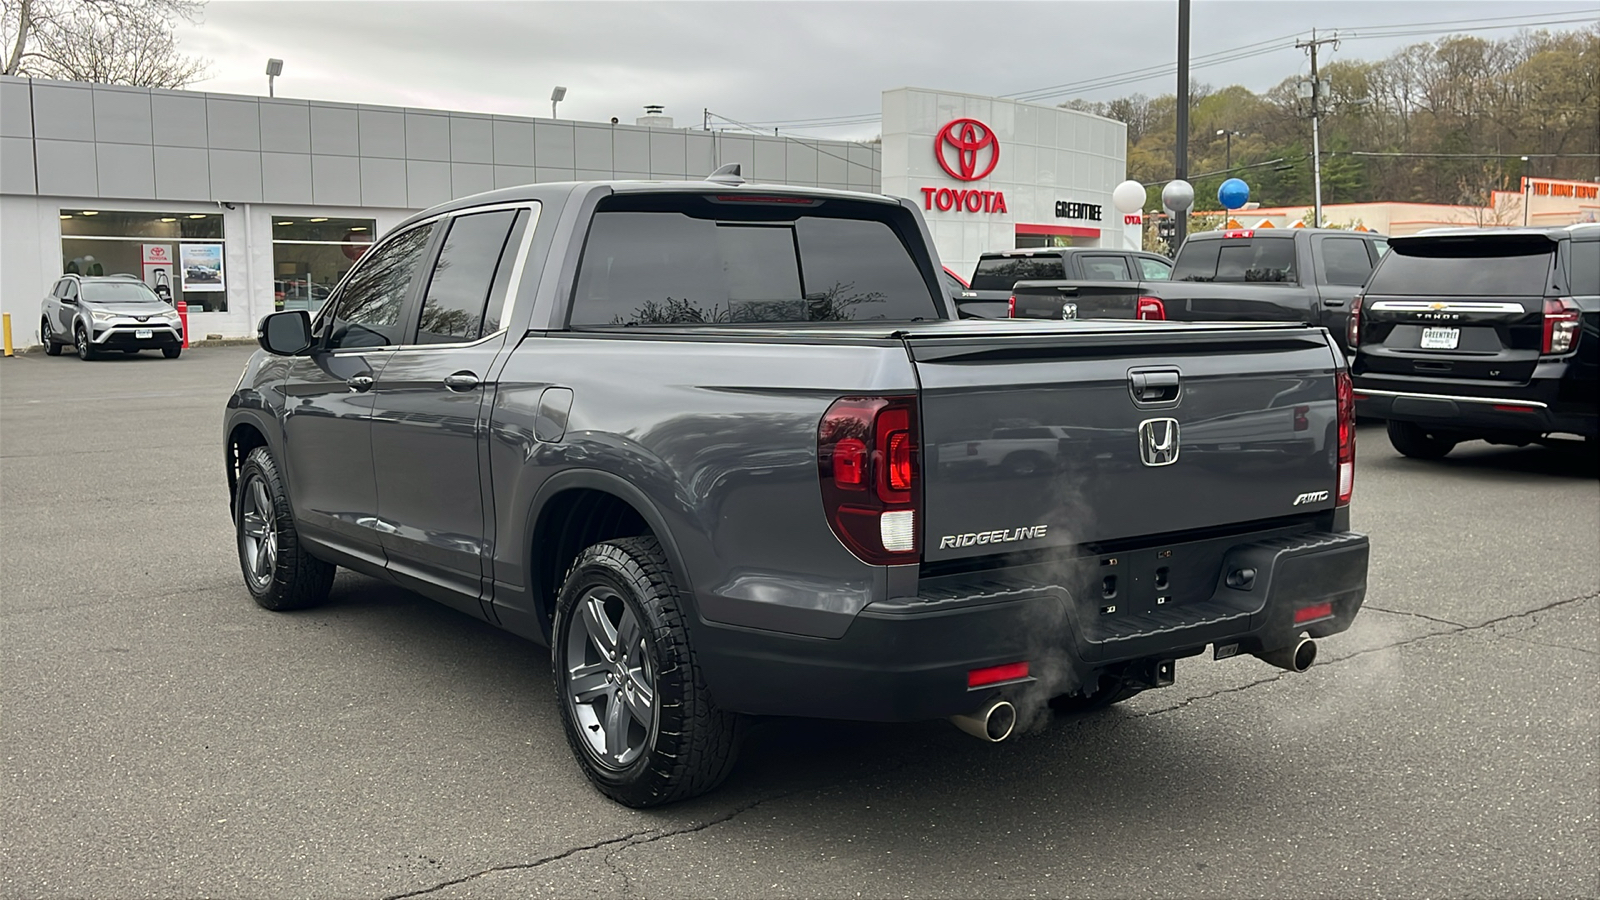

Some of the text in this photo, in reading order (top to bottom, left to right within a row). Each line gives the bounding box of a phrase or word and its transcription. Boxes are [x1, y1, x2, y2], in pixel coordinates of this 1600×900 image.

[1533, 182, 1599, 199] THE HOME DEPOT
[920, 187, 1007, 213] TOYOTA
[1055, 200, 1102, 221] GREENTREE
[1124, 215, 1142, 225] OTA
[1424, 330, 1458, 340] GREENTREE
[1292, 490, 1329, 506] AWD
[939, 524, 1048, 550] RIDGELINE
